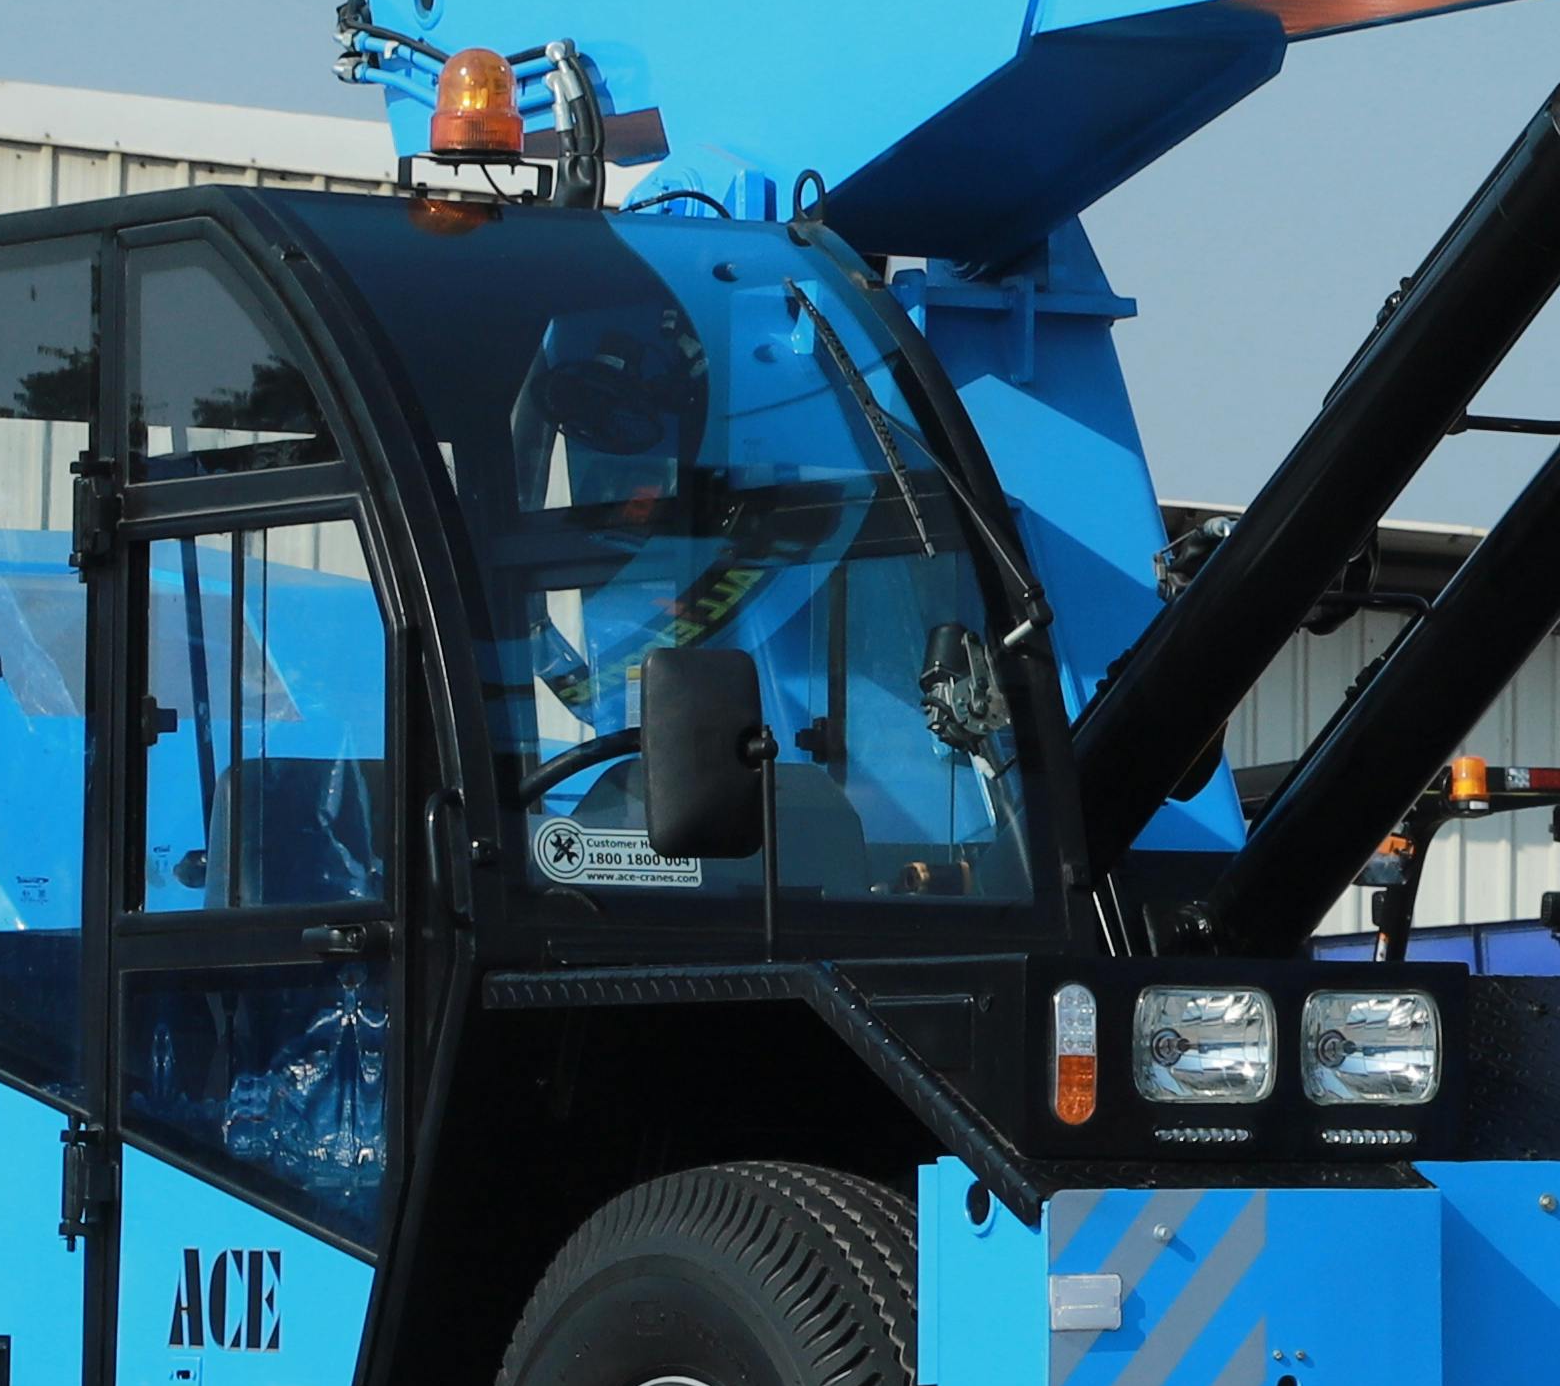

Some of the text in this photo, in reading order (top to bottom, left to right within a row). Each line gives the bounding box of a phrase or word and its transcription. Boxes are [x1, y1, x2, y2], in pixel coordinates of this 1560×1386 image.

[586, 838, 638, 850] Customer
[588, 852, 622, 865] 1800
[627, 853, 660, 866] 1800
[586, 873, 699, 883] www.ace-cranes.com
[167, 1247, 282, 1352] ACE
